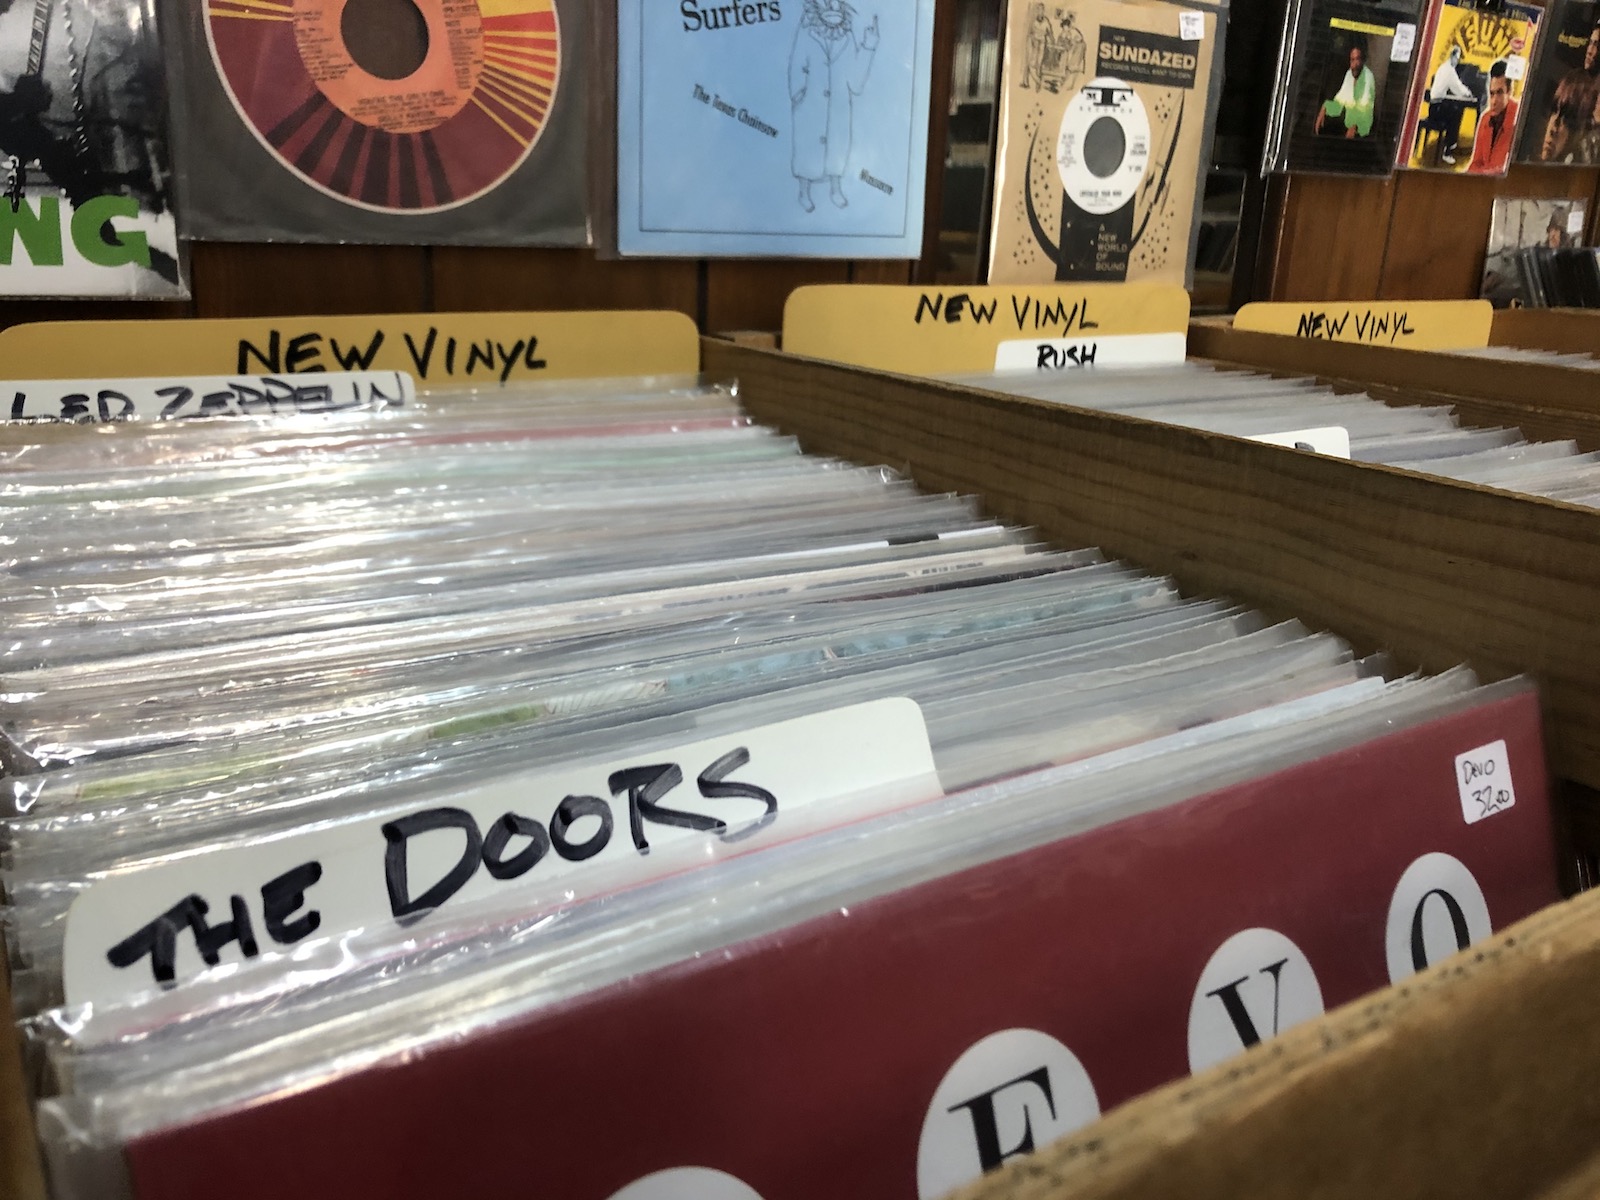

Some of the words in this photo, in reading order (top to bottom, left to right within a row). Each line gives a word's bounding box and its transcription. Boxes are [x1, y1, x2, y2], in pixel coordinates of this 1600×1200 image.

[680, 0, 782, 32] Surfers
[1099, 41, 1196, 71] SUNDAZED
[1097, 243, 1128, 253] WORLD
[914, 292, 998, 325] NEW
[1011, 294, 1099, 338] VINYL
[1296, 310, 1350, 340] NEW
[1355, 309, 1415, 344] VINYL
[237, 329, 386, 374] NEW
[403, 326, 549, 388] VINYL
[1036, 342, 1098, 369] RUSH
[106, 860, 324, 991] THE
[381, 745, 780, 927] DOORS
